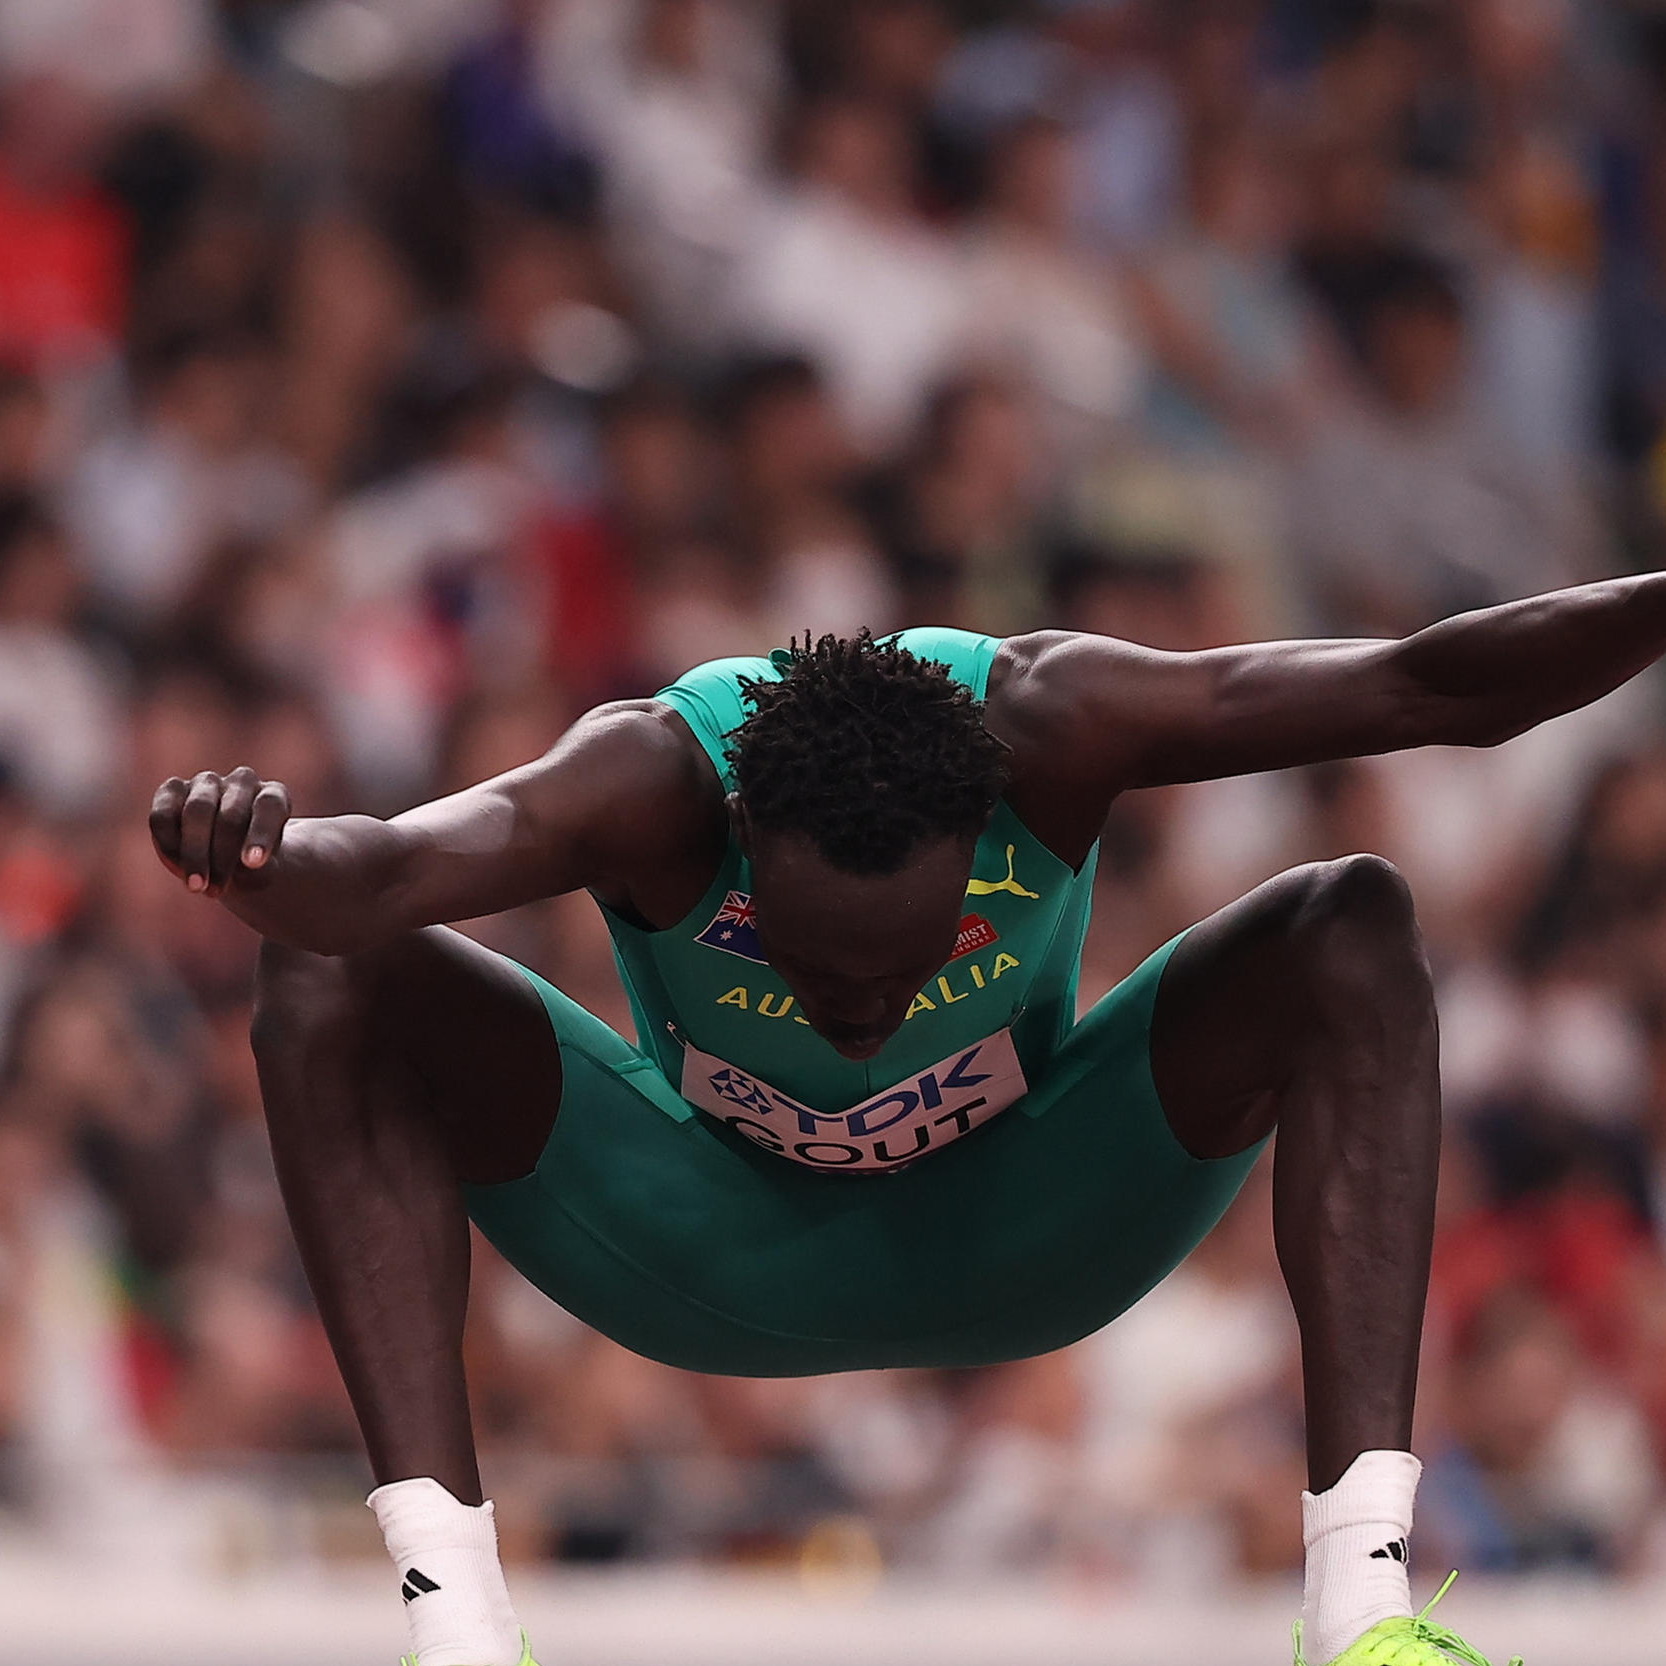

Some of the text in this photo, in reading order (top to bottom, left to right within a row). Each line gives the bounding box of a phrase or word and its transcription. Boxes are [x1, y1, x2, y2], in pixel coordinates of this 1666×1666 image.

[715, 952, 1021, 1025] AUALIA
[771, 1045, 993, 1137] TDK
[724, 1096, 988, 1166] GOUT
